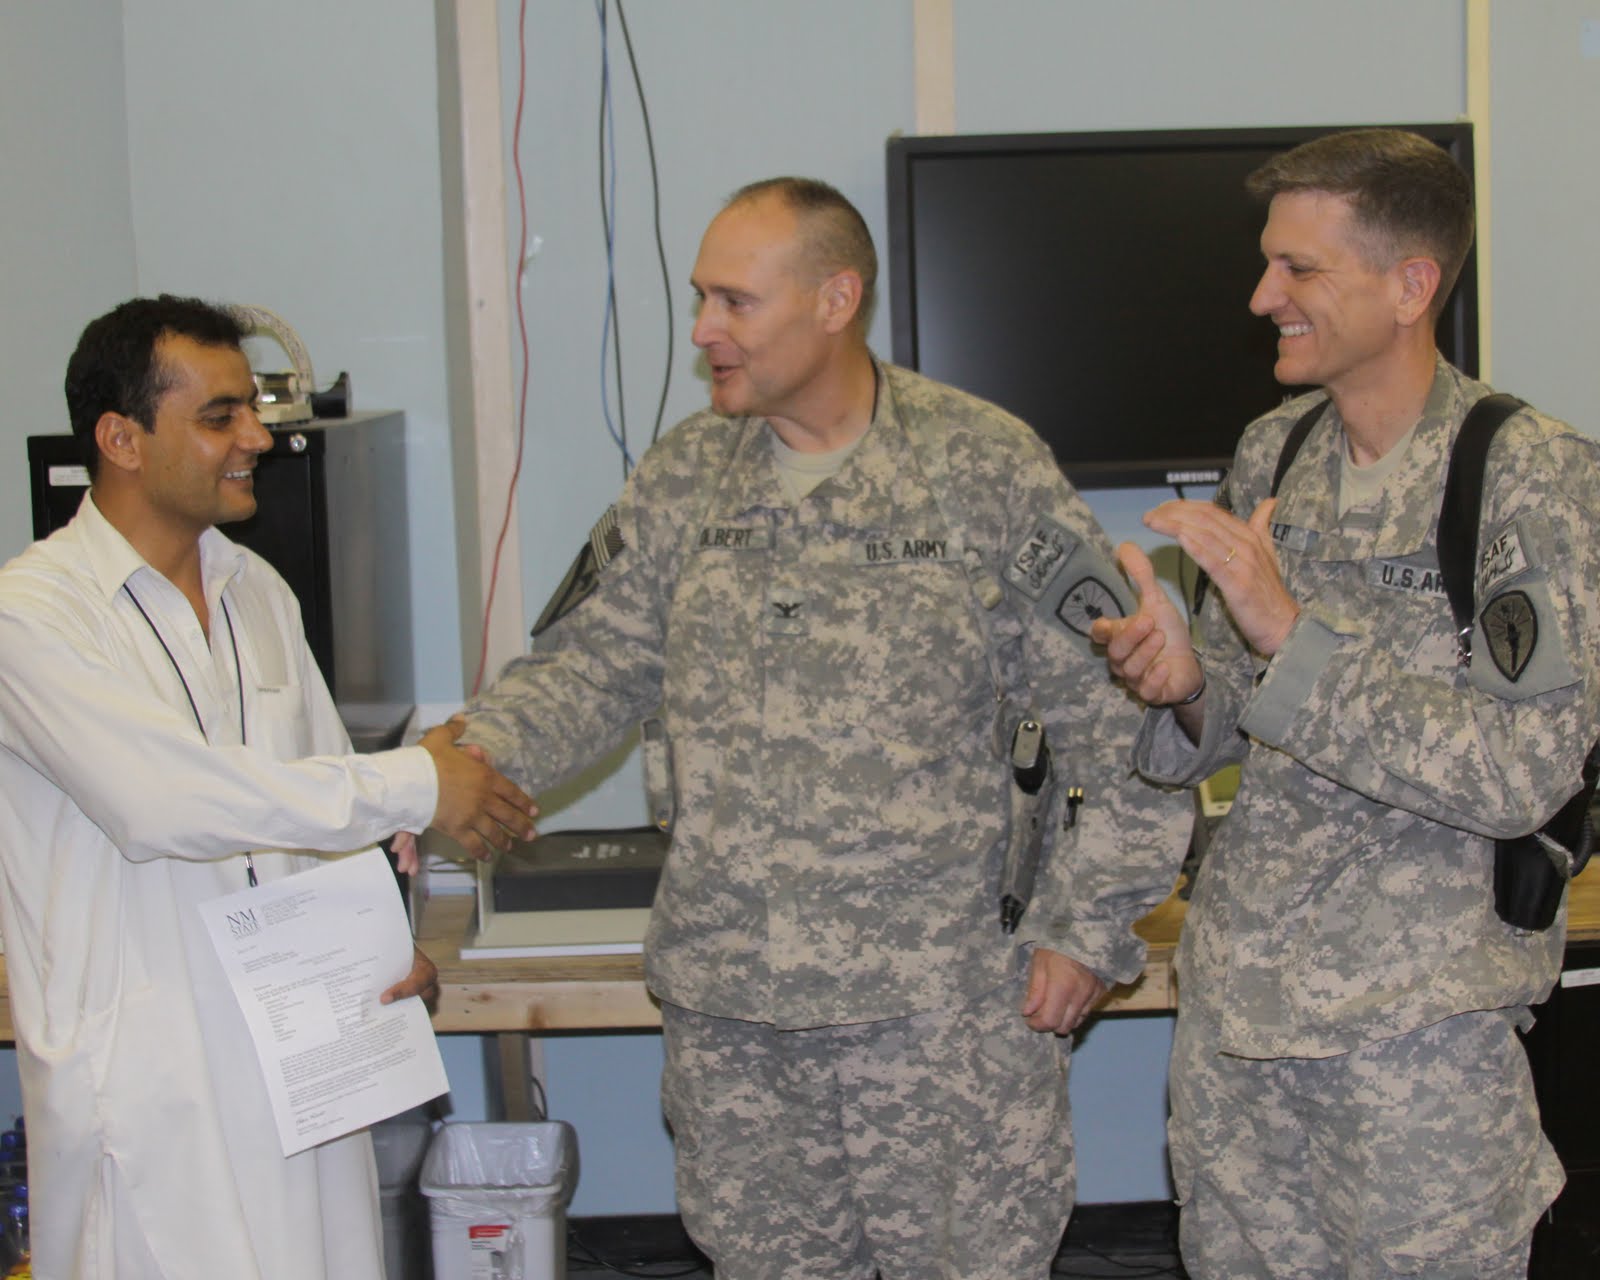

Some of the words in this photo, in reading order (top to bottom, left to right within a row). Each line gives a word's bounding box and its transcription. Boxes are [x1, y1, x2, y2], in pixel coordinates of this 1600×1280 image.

[1166, 471, 1219, 483] SAMSUNG
[866, 541, 897, 562] U.S.
[902, 539, 947, 559] ARMY
[1014, 529, 1048, 576] ISAF
[1382, 564, 1417, 590] U.S.
[226, 908, 256, 930] NM
